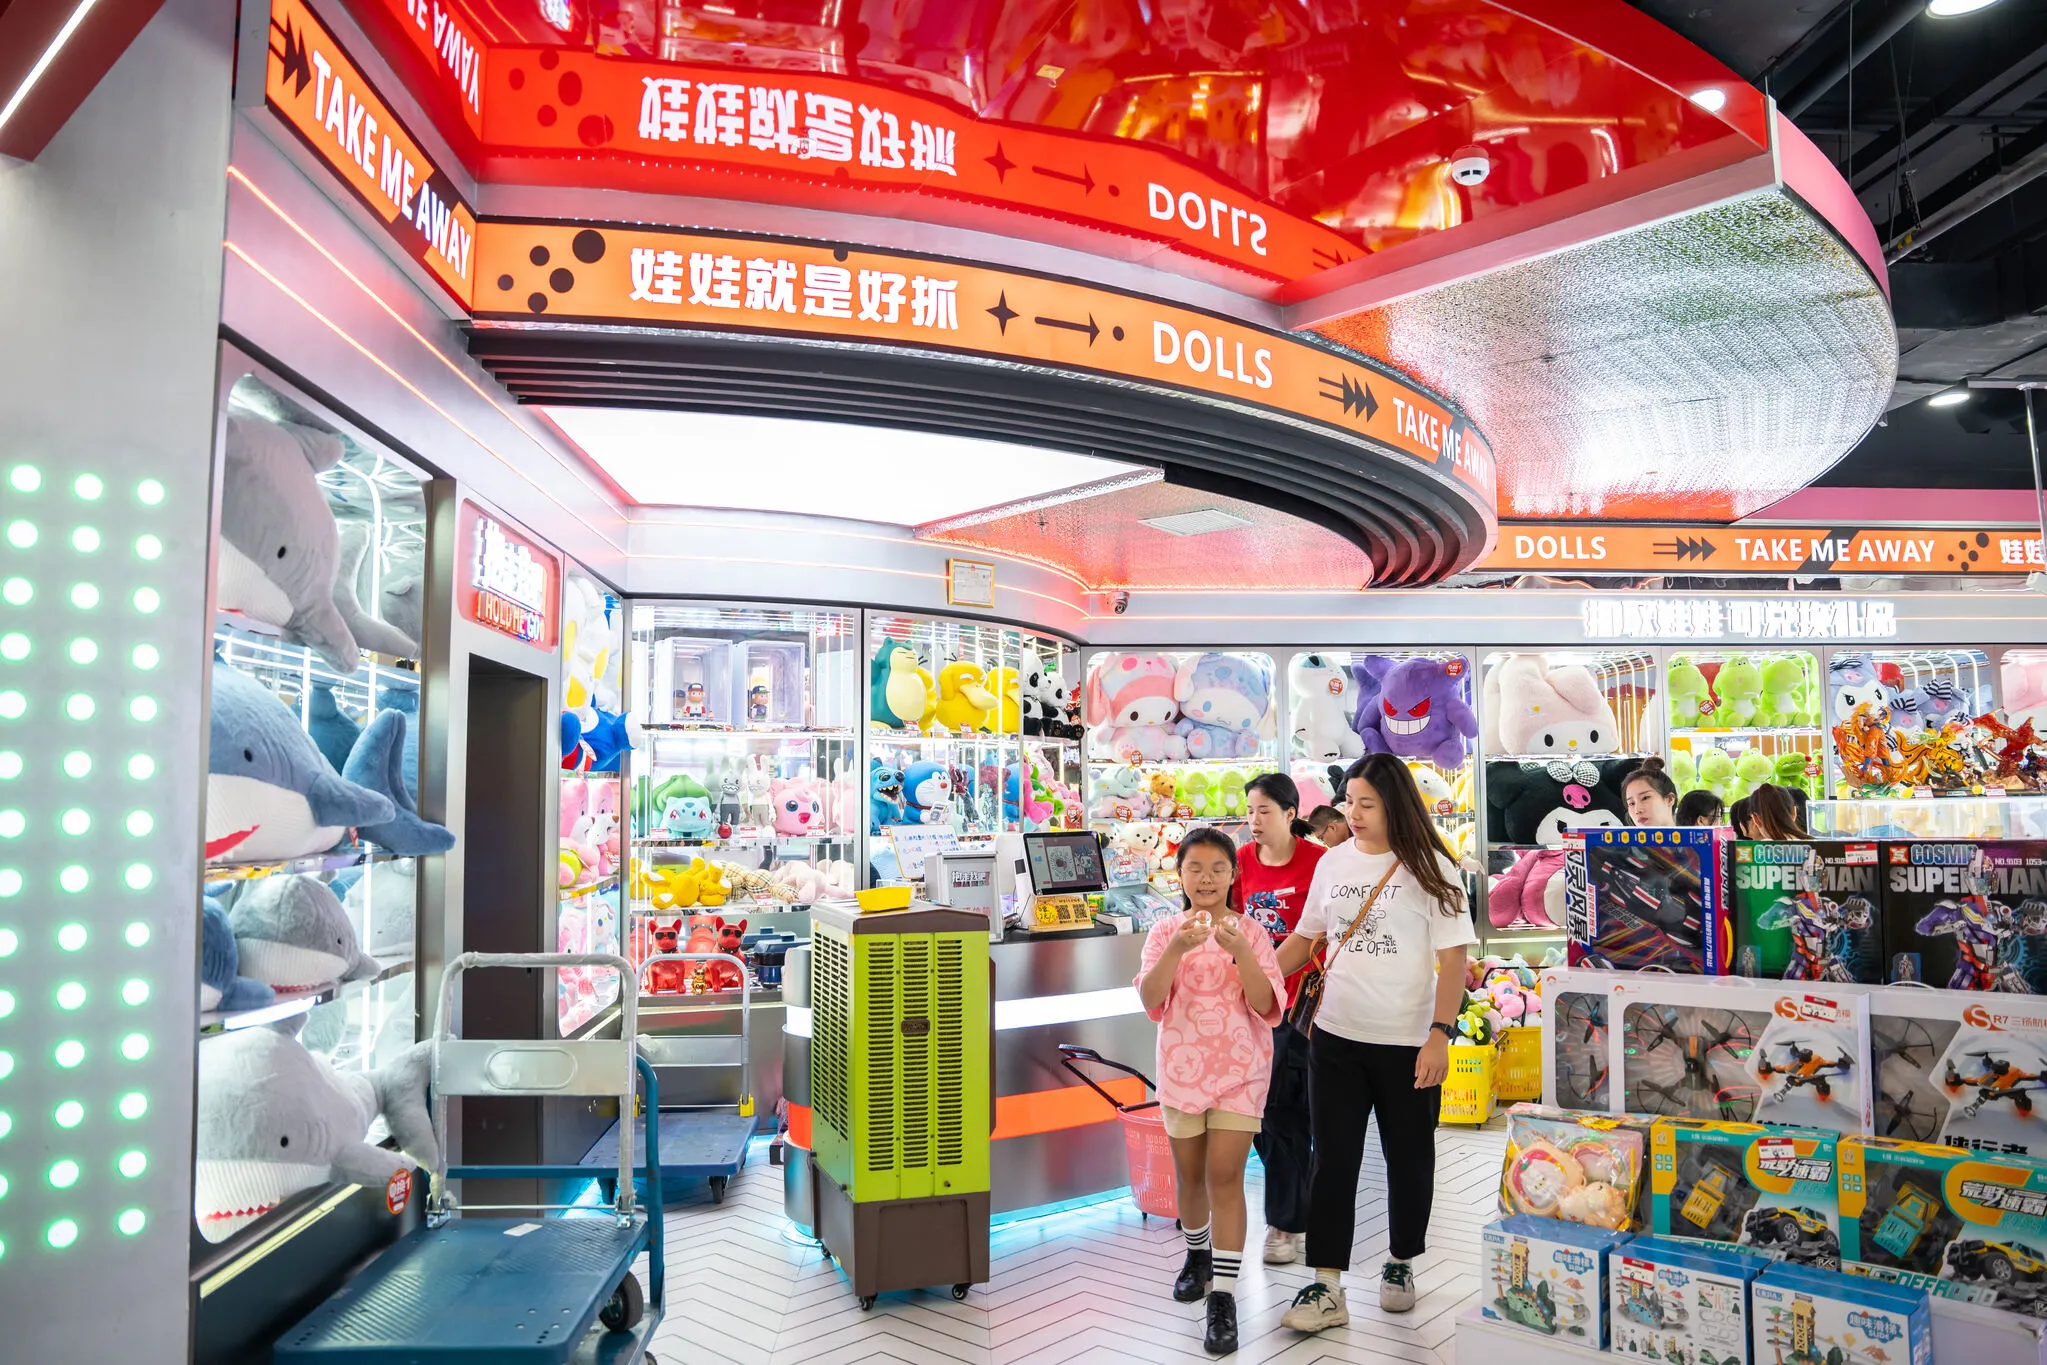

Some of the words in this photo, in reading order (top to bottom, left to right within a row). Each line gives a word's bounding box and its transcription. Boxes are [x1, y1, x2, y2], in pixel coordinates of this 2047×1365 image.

[312, 49, 378, 179] TAKE
[380, 134, 415, 221] ME
[415, 181, 471, 280] AWAY
[629, 247, 959, 330] 娃娃就是好抓
[1153, 320, 1273, 389] DOLLS
[1392, 396, 1439, 452] TAKE
[1442, 423, 1462, 467] ME
[1515, 535, 1607, 560] DOLLS
[1735, 538, 1803, 562] TAKE
[1811, 538, 1850, 562] ME
[1857, 539, 1936, 563] AWAY
[1993, 1014, 2009, 1025] R7
